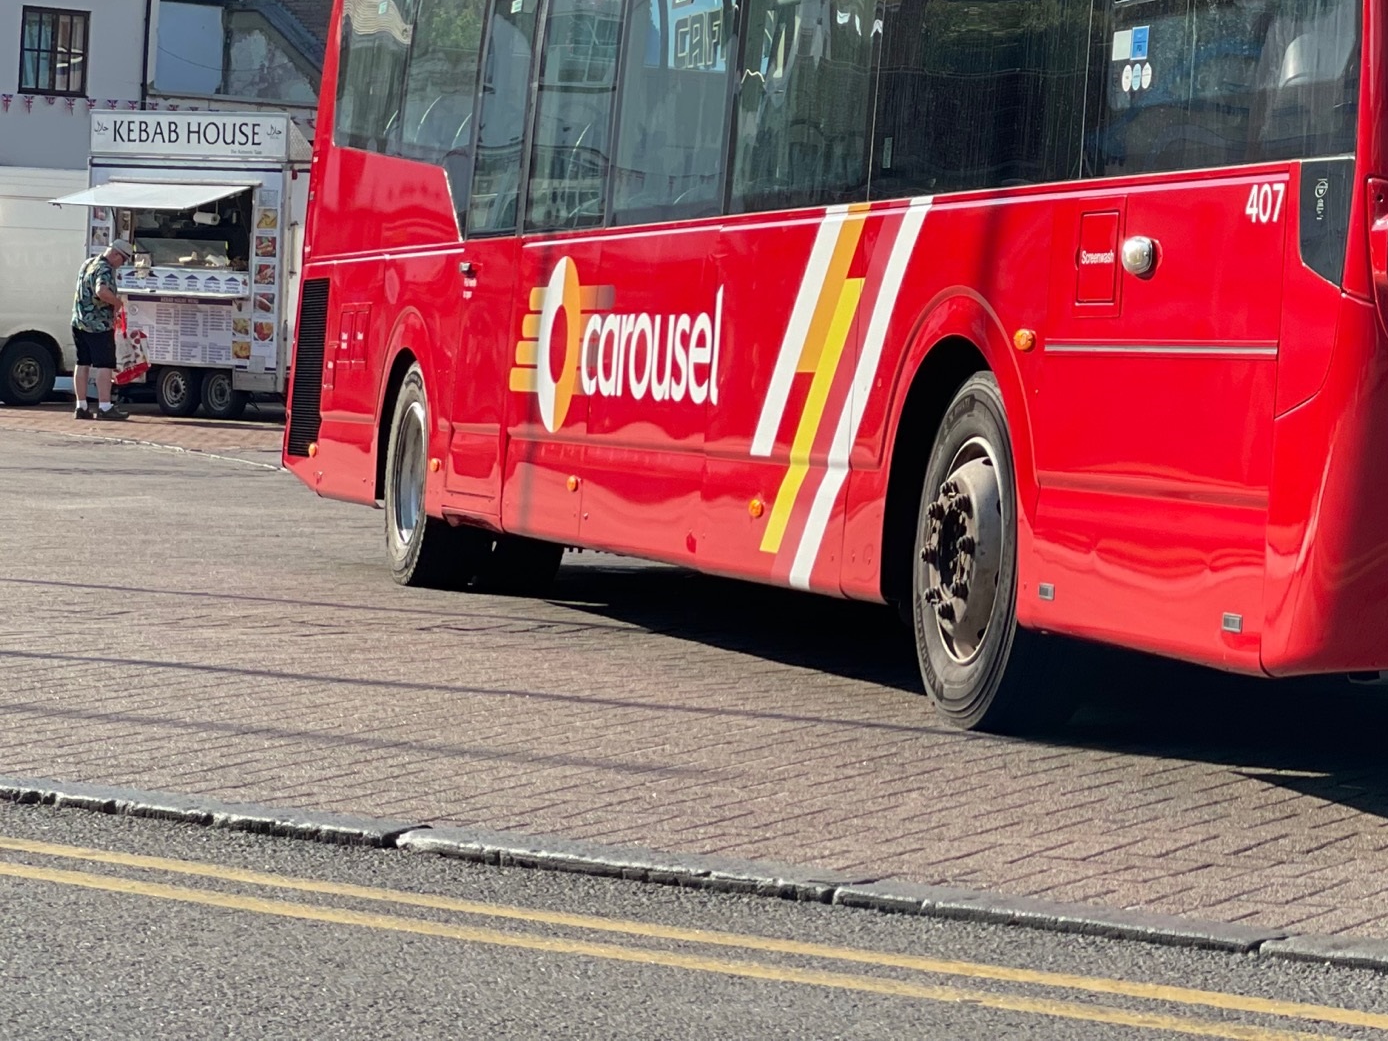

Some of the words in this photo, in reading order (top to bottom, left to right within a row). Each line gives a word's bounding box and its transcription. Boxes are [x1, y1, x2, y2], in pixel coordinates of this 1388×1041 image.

[113, 120, 179, 143] KEBAB
[187, 122, 262, 146] HOUSE
[1245, 183, 1286, 224] 407
[1081, 249, 1115, 265] Screenwash
[581, 284, 724, 406] carousel
